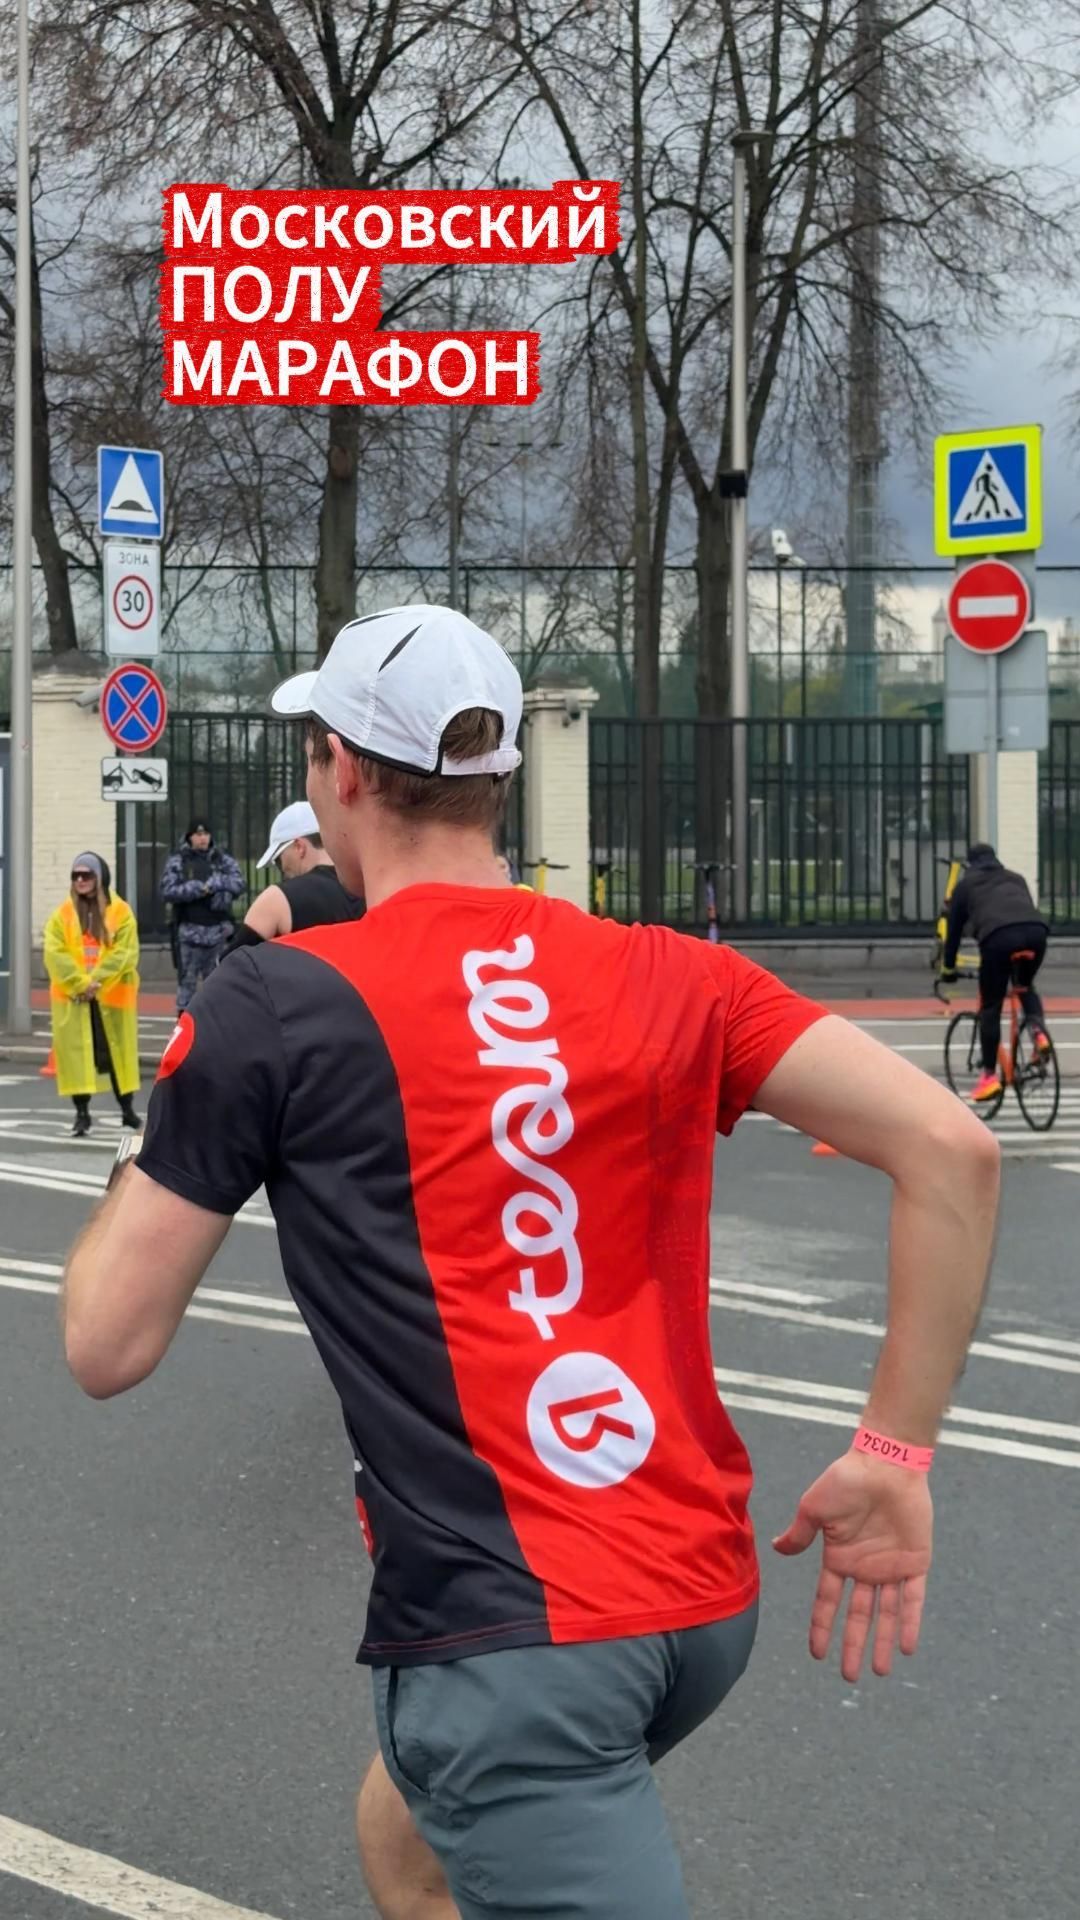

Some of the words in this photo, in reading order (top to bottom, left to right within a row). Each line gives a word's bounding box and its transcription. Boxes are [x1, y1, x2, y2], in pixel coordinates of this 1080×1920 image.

[118, 552, 150, 566] ЗОНА
[122, 590, 145, 612] 30
[462, 933, 584, 1341] team
[863, 1432, 909, 1462] 14034
